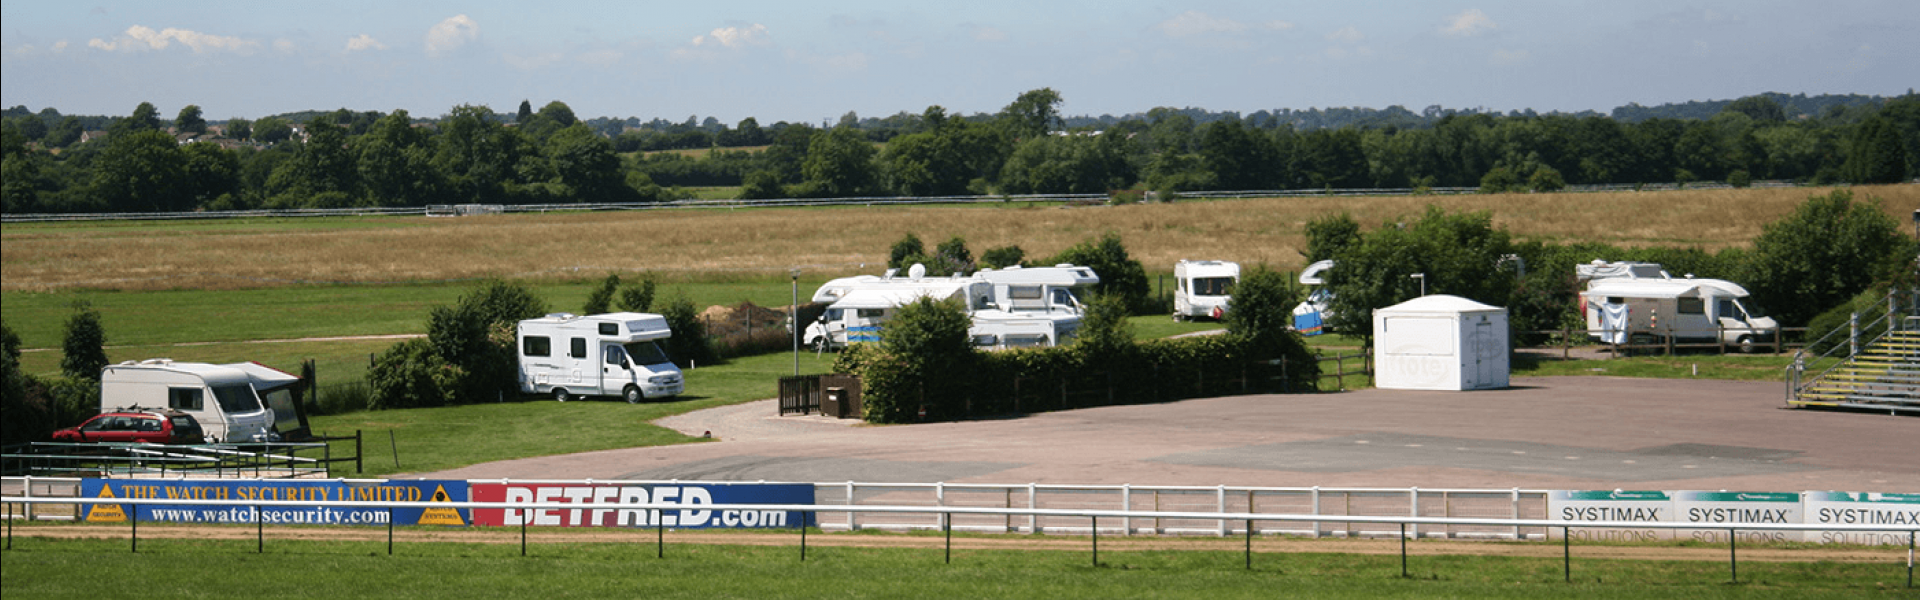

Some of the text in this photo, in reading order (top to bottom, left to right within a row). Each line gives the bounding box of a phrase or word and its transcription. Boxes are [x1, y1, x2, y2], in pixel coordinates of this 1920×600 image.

[121, 485, 423, 503] THE WATCH SECURITY LIMITED
[151, 506, 390, 524] www.watchsecurity.com
[1562, 506, 1660, 522] SYSTIMAX
[1688, 507, 1789, 524] SYSTIMAX
[1819, 507, 1920, 525] SYSTIMAX
[1566, 529, 1659, 542] SOLUTIONS
[1691, 530, 1786, 544] SOLUTIONS
